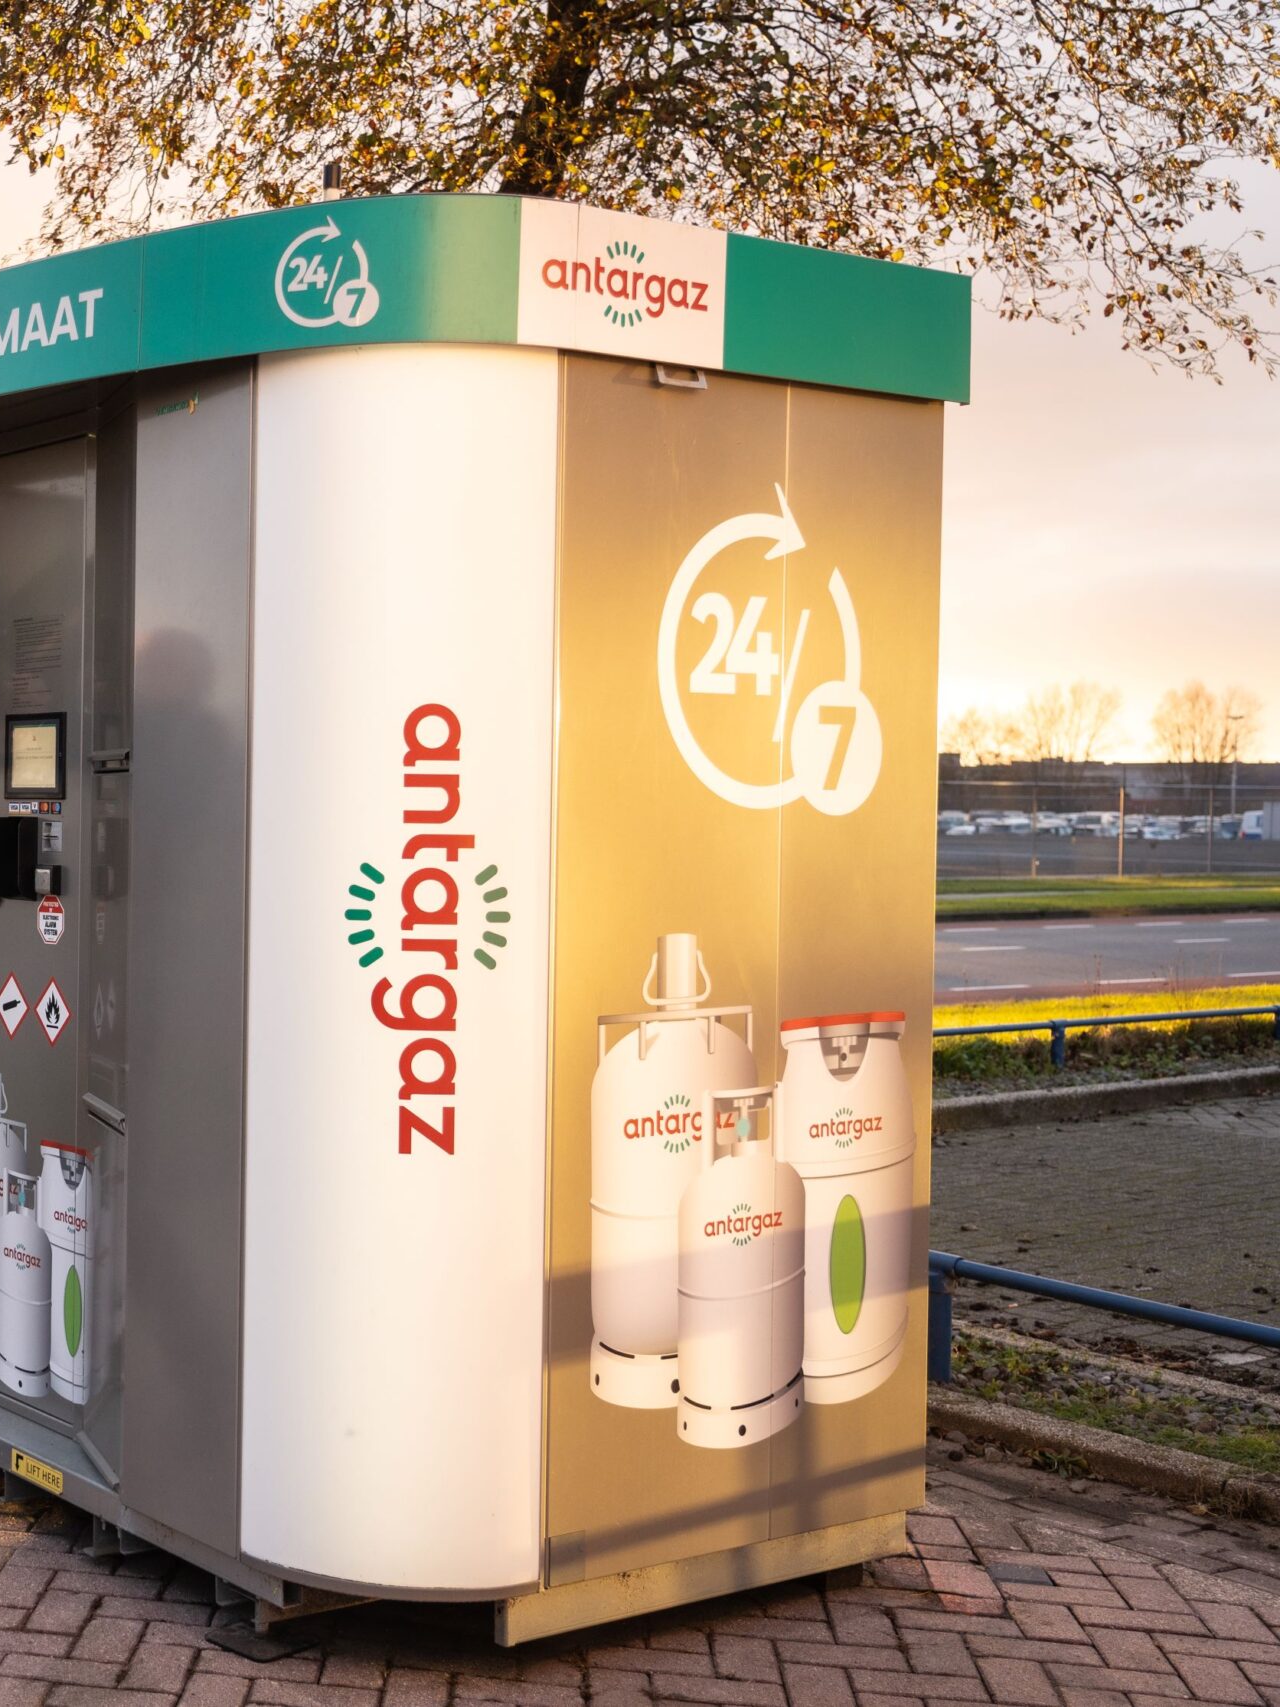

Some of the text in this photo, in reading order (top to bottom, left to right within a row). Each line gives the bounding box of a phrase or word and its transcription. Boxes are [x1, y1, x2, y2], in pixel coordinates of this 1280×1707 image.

[542, 257, 709, 318] antargaz
[371, 703, 475, 1155] antargaz
[809, 1116, 882, 1140] antargaz
[704, 1211, 783, 1237] antargaz
[3, 1246, 41, 1268] antargaz
[26, 1463, 61, 1489] LIFT HERE
